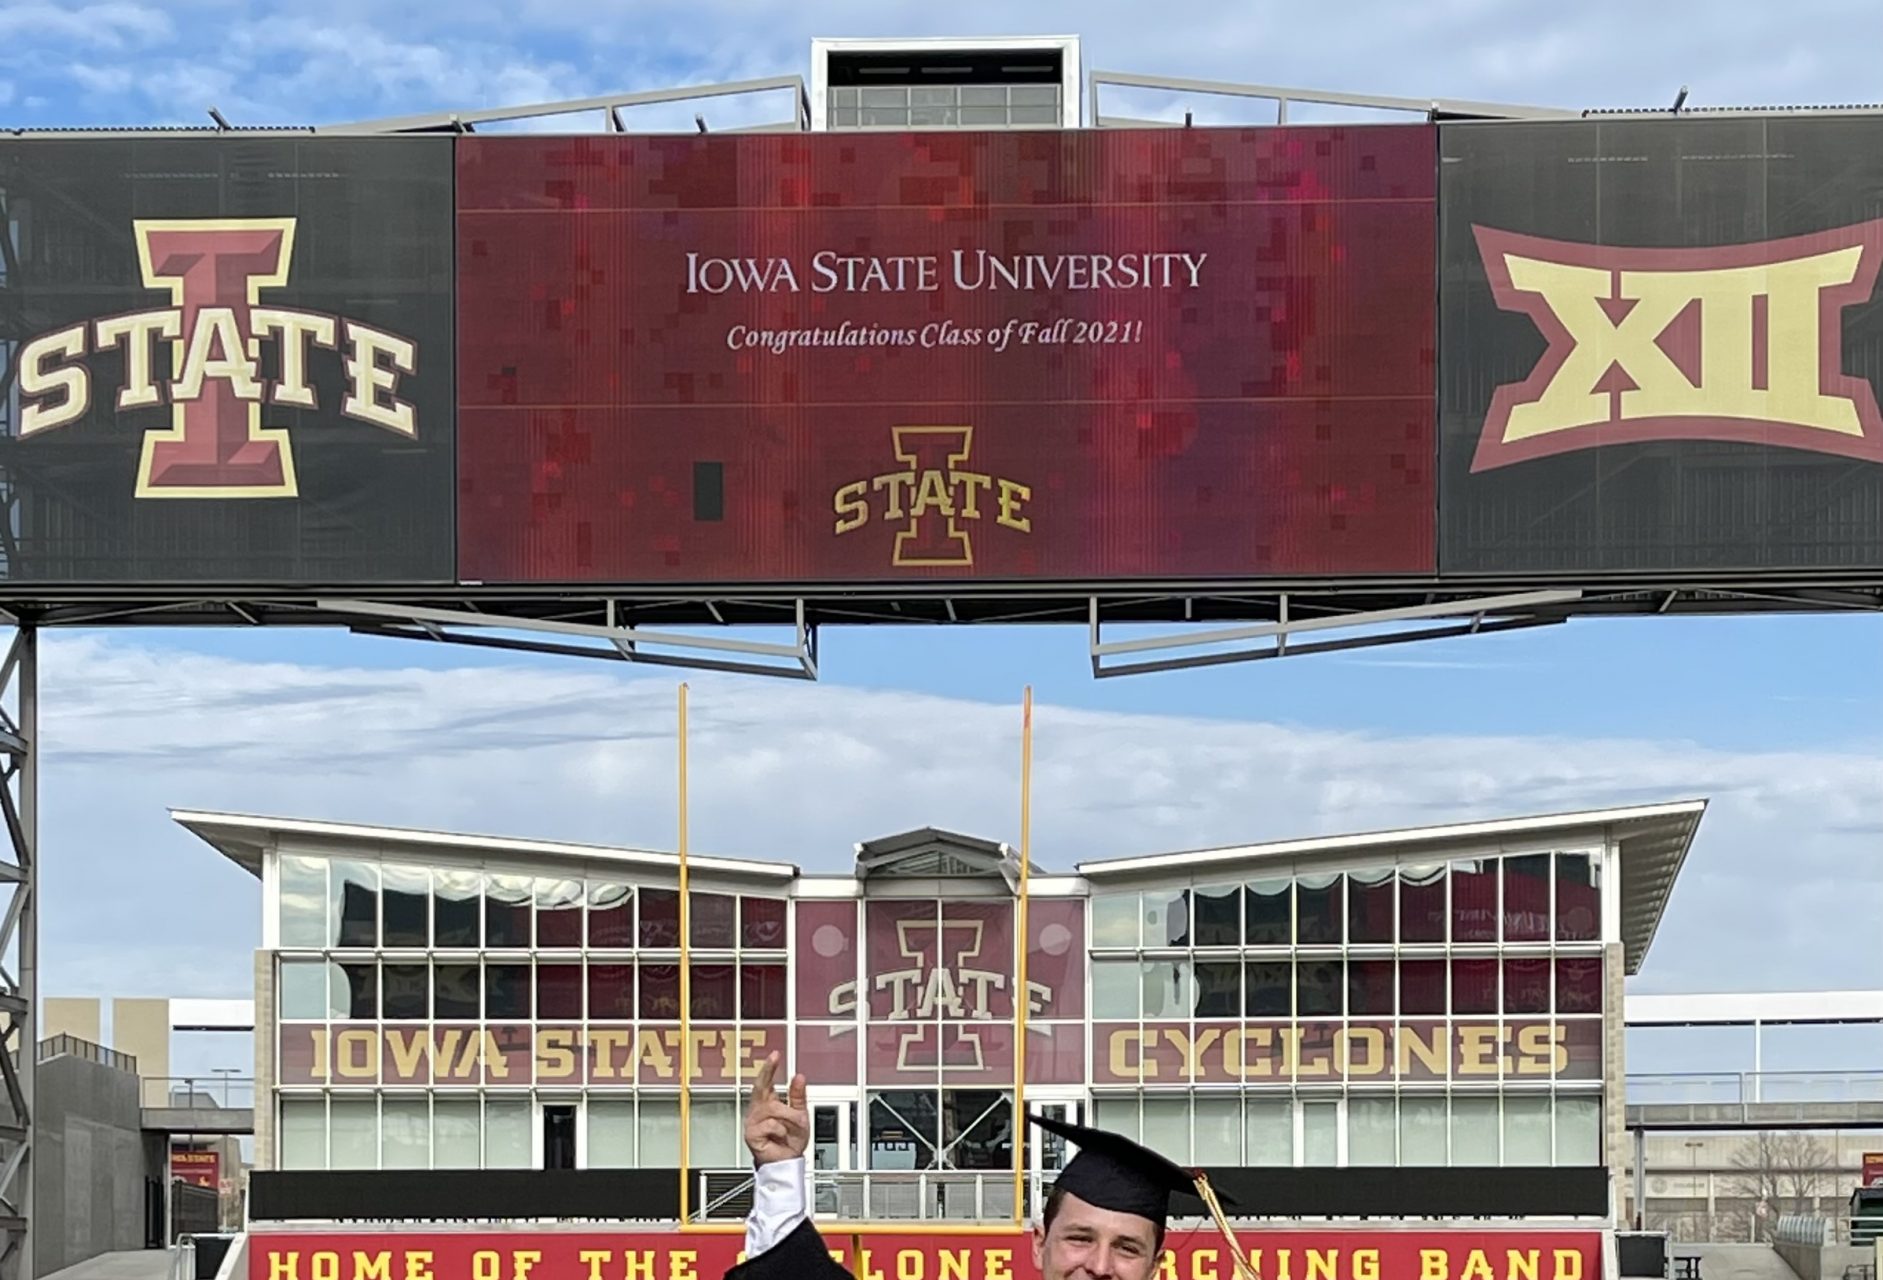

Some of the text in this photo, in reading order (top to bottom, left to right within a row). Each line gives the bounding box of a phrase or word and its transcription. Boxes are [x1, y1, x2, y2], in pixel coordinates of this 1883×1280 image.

[685, 249, 1207, 293] IOWA STATE UNIVERSITY
[726, 319, 1142, 354] Congratulations Class of Fall 2021!
[1501, 244, 1865, 445] XII
[18, 305, 417, 438] STATE
[833, 469, 1032, 535] STATE
[828, 967, 1053, 1037] STATE
[310, 1025, 1569, 1078] IOWA STATE CYCLONES
